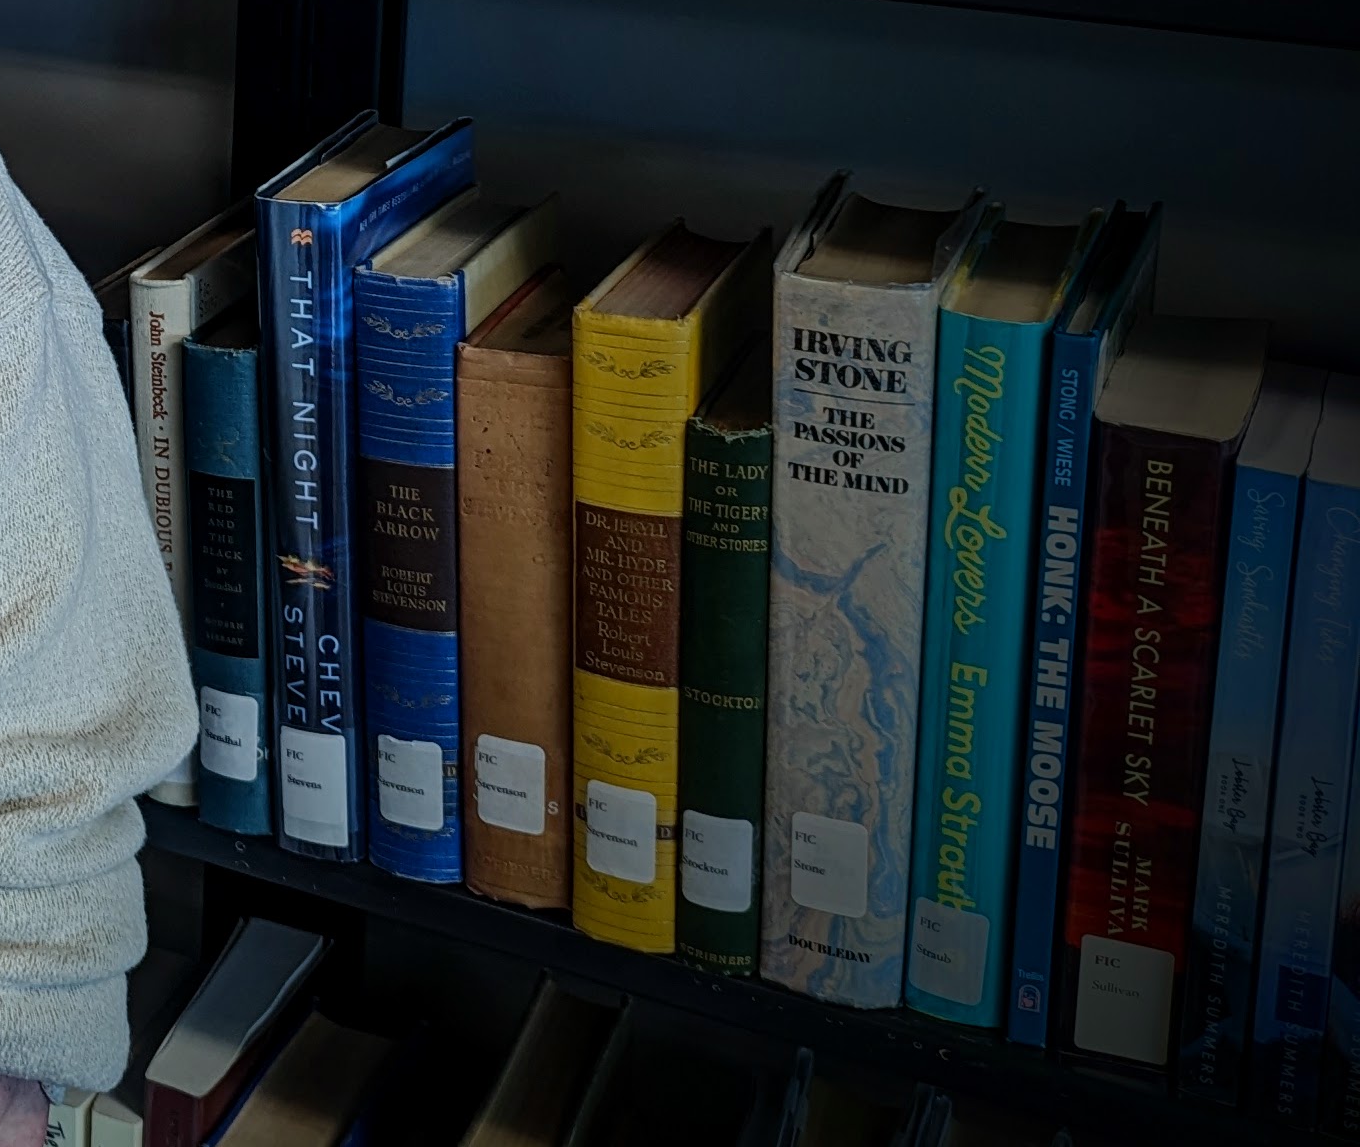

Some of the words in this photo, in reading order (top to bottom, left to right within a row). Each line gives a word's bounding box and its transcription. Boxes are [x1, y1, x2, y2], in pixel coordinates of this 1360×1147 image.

[286, 270, 316, 378] THAT
[792, 326, 913, 365] IRVING
[794, 357, 907, 394] STONE
[822, 406, 875, 430] THE
[793, 420, 906, 454] PASSIONS
[291, 400, 319, 531] NIGHT
[689, 456, 723, 478] THE
[725, 460, 769, 481] LADY
[832, 449, 864, 469] OF
[715, 484, 739, 499] OR
[787, 461, 838, 487] THE
[842, 471, 909, 495] MIND
[389, 484, 421, 502] THE
[375, 500, 435, 523] BLACK
[687, 495, 714, 517] THE
[716, 500, 769, 522] TIGER?
[373, 519, 440, 541] ARROW
[584, 510, 612, 532] DR.
[613, 516, 668, 538] JEKYLL
[711, 520, 741, 534] AND
[1140, 458, 1175, 587] BENEATH
[605, 534, 642, 553] AND
[685, 528, 721, 550] OTHER
[719, 535, 769, 553] STORIES
[585, 546, 614, 566] MR.
[617, 552, 668, 573] HYDE
[1040, 504, 1080, 625] HONK:
[380, 565, 433, 586] ROBERT
[387, 580, 427, 598] LOUIS
[581, 564, 612, 584] AND
[616, 571, 675, 592] OTHER
[371, 590, 447, 613] STEVENSON
[588, 581, 663, 608] FAMOUS
[1135, 592, 1164, 615] A
[595, 600, 653, 625] TALES
[596, 620, 652, 646] Robert
[601, 638, 644, 663] Louis
[584, 649, 666, 682] Stevenson
[1034, 637, 1070, 711] THE
[1125, 625, 1161, 746] SCARLET
[1024, 722, 1066, 853] MOOSE
[1122, 750, 1153, 809] SKY
[1130, 854, 1153, 933] MARK
[788, 934, 873, 964] DOUBLEDAY
[915, 942, 952, 965] Straub
